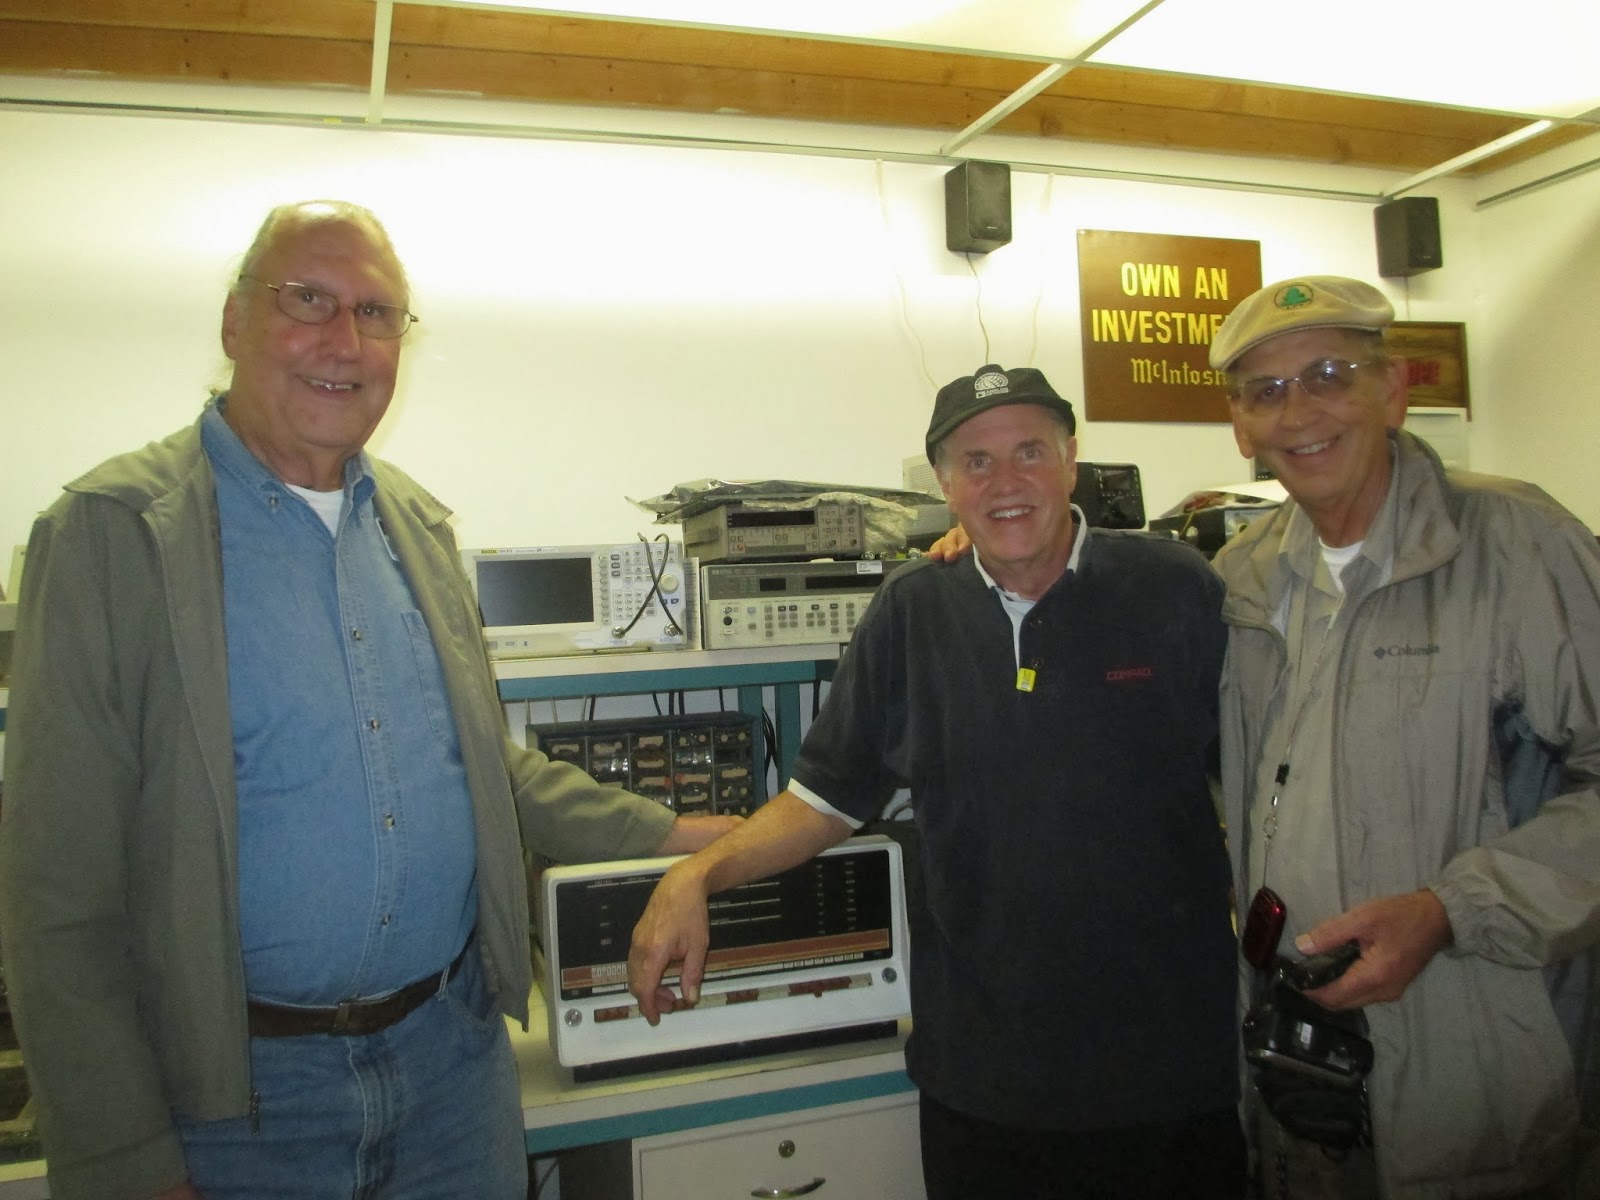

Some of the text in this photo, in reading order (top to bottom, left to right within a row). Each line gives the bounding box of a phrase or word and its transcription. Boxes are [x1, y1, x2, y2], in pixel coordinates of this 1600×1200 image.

[1121, 261, 1229, 301] OWN AN
[1092, 309, 1229, 345] INVESTME
